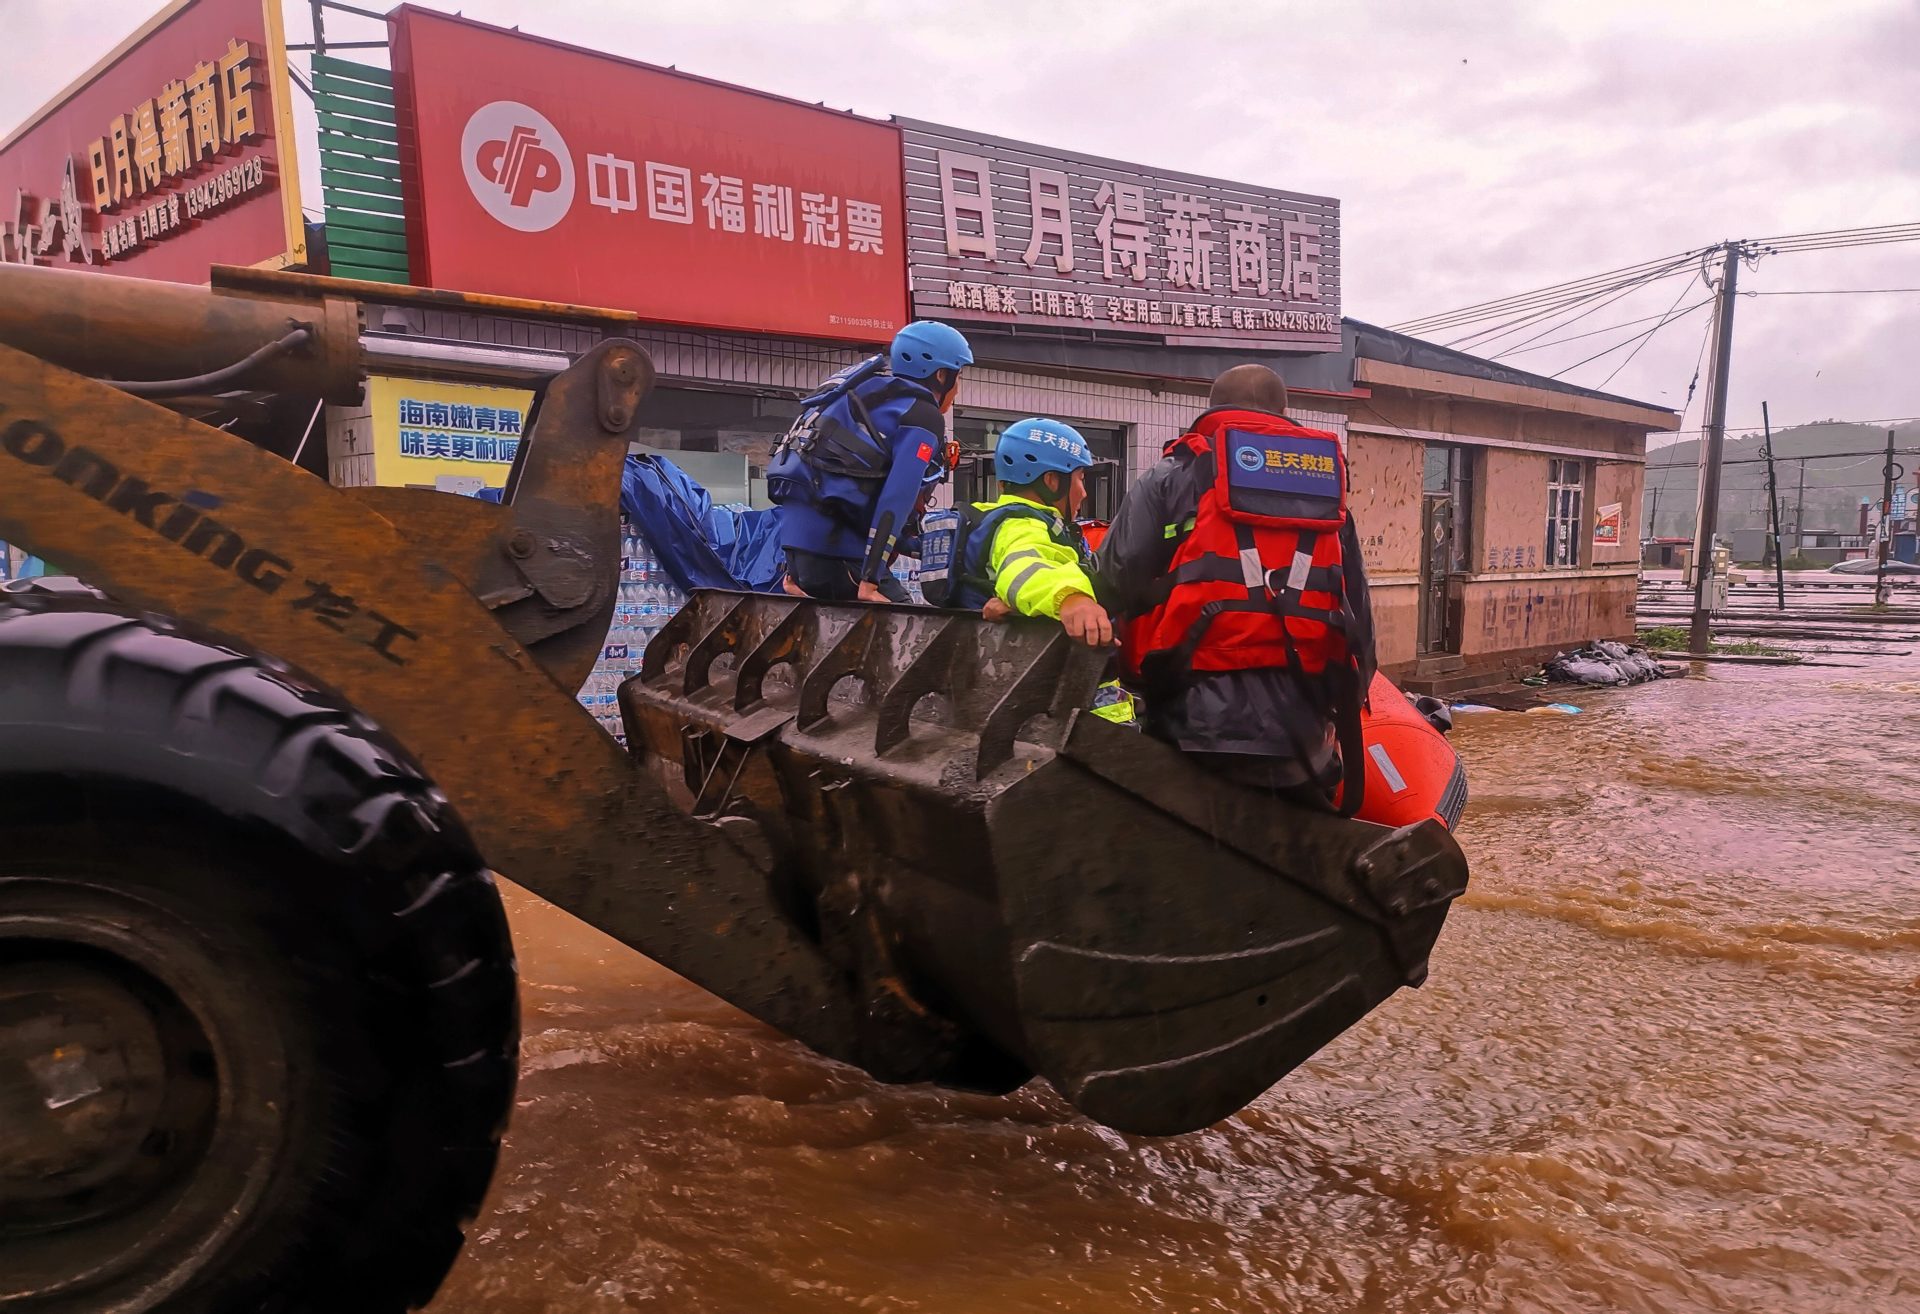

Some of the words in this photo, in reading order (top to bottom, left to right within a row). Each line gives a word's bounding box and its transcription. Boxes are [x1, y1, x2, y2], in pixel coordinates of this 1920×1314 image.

[88, 37, 254, 214] 日月得薪商店
[139, 192, 180, 241] 日用百货
[184, 154, 263, 218] 13942969128
[587, 153, 884, 255] 中国福利彩票
[938, 149, 1320, 299] 日月得薪商店
[948, 280, 1018, 315] 烟酒糖茶
[1031, 290, 1095, 320] 日用百货
[1106, 297, 1162, 324] 学生用品
[1170, 302, 1223, 329] 儿童玩具
[400, 399, 521, 433] 海南嫩青果
[1028, 429, 1082, 458] 蓝天救援
[1264, 449, 1335, 474] 蓝天救援
